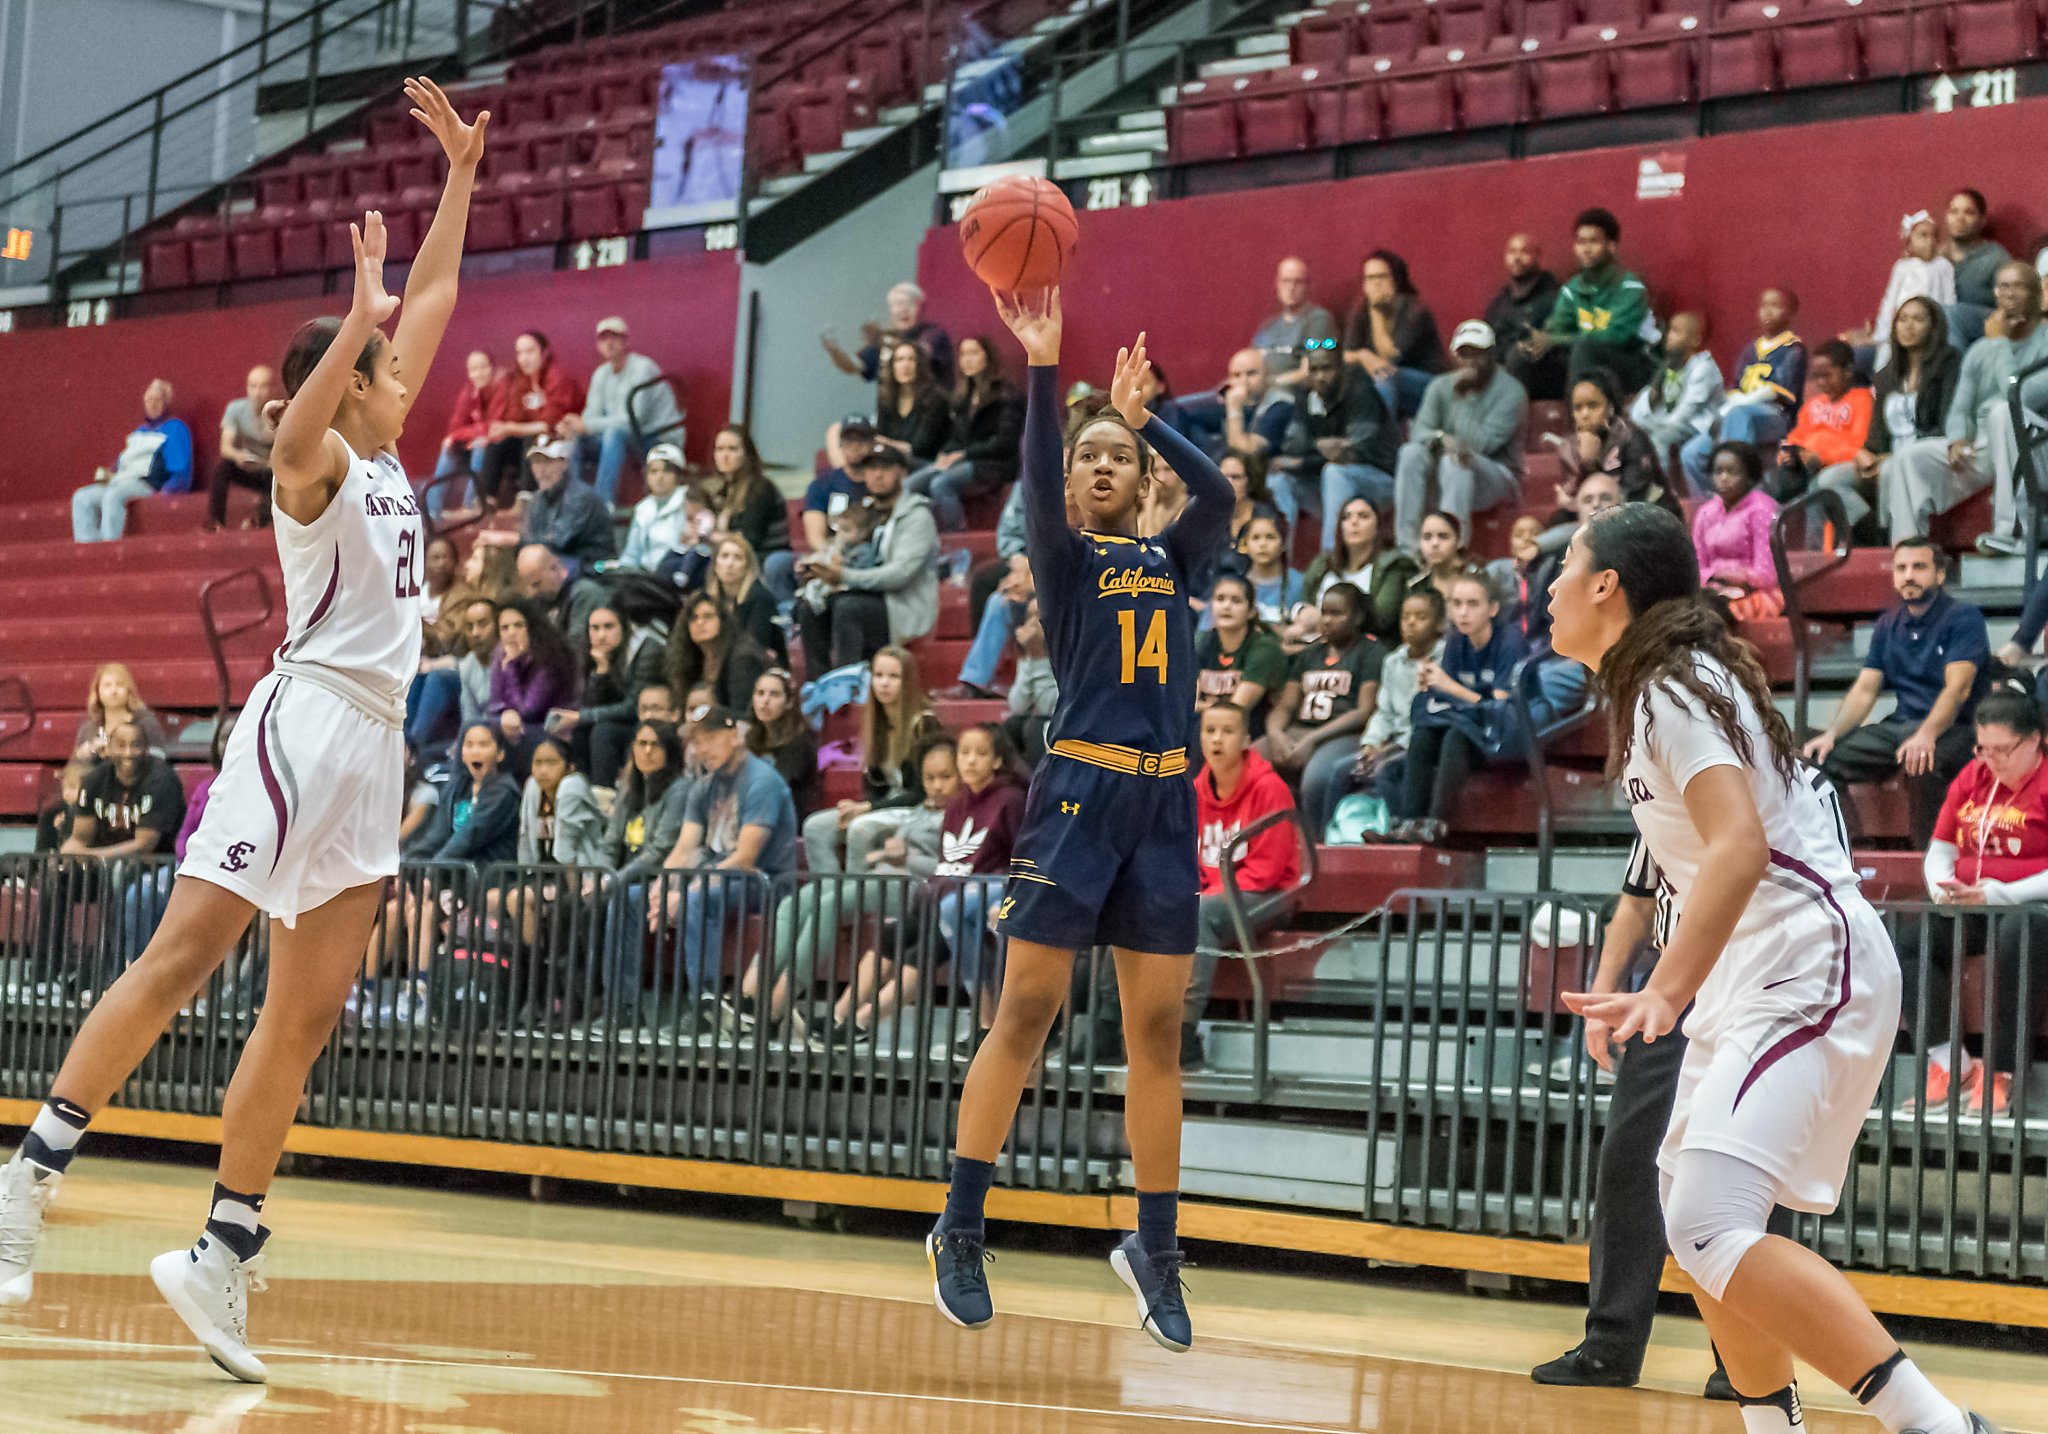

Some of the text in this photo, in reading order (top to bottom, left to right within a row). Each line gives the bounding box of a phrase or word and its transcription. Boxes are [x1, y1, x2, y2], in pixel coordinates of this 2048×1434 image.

[1970, 67, 2017, 107] 211
[395, 529, 421, 598] 21
[1098, 566, 1176, 599] California
[1117, 609, 1168, 685] 14
[1300, 690, 1336, 720] 15
